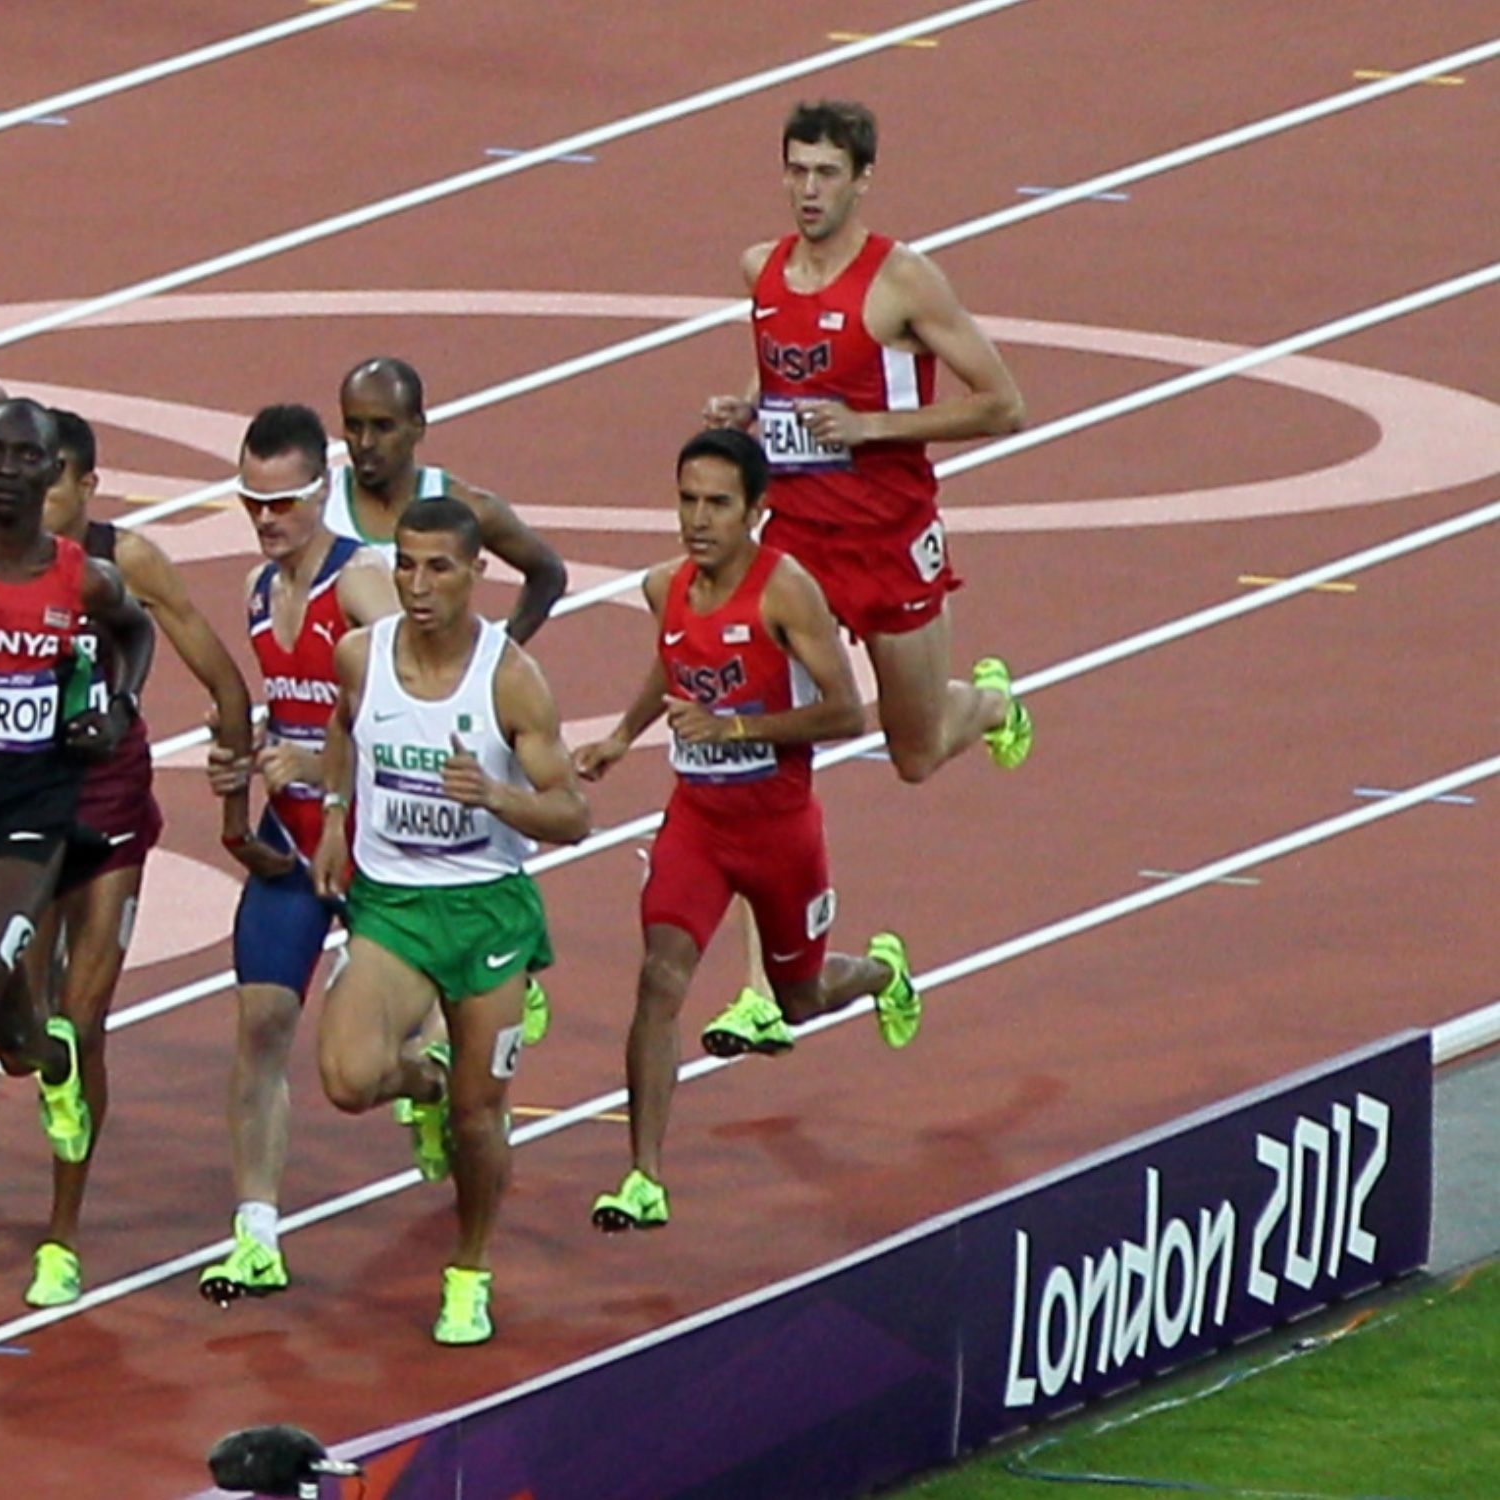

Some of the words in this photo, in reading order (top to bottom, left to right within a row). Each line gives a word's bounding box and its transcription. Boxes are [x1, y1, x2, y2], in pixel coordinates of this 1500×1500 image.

[761, 332, 831, 383] USA
[265, 675, 339, 706] ORWAY
[671, 653, 747, 704] USA
[373, 743, 477, 773] ALGER
[1004, 1167, 1236, 1407] London
[1248, 1092, 1390, 1305] 2012
